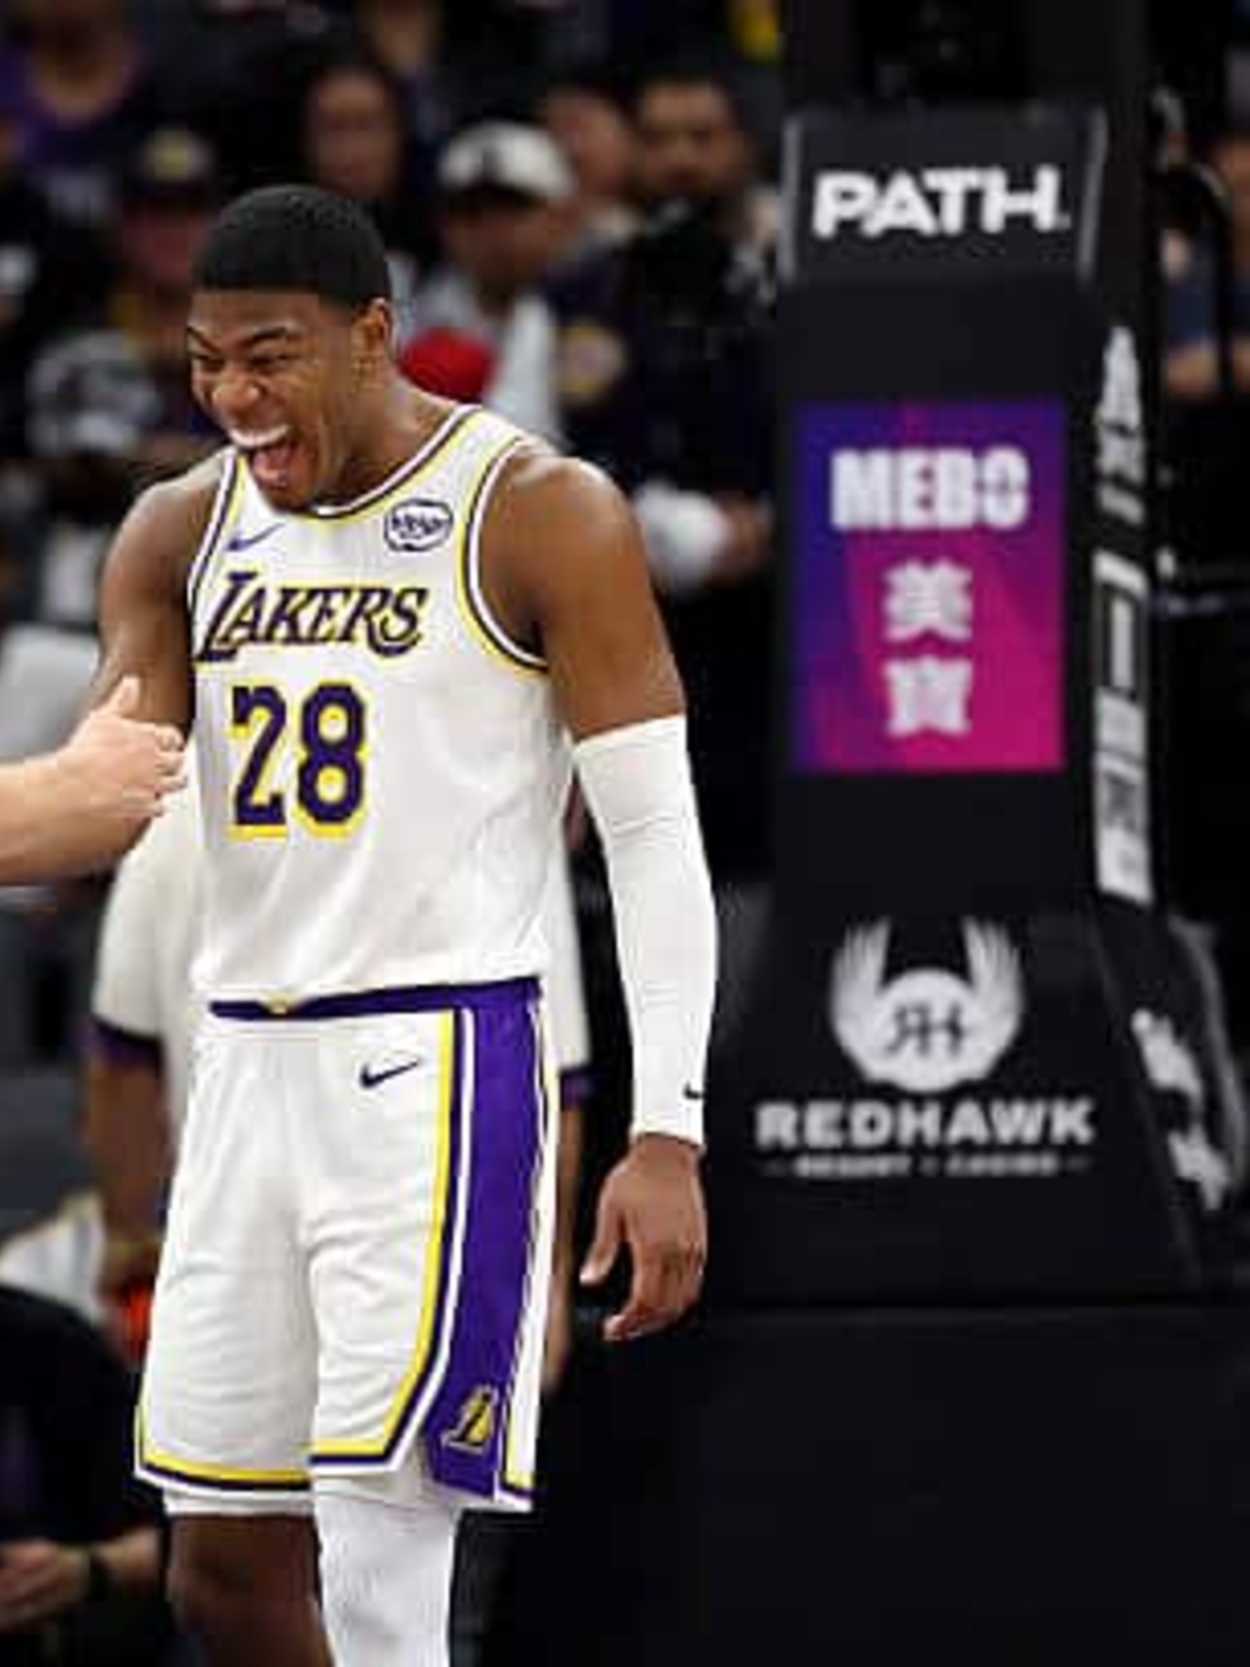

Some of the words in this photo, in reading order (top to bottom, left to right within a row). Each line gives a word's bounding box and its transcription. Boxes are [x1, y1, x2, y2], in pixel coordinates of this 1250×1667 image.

[813, 165, 1059, 237] PATH
[830, 447, 1030, 529] MEBO
[193, 571, 429, 662] LAKERS
[229, 680, 369, 837] 28
[756, 1097, 1096, 1149] REDHAWK
